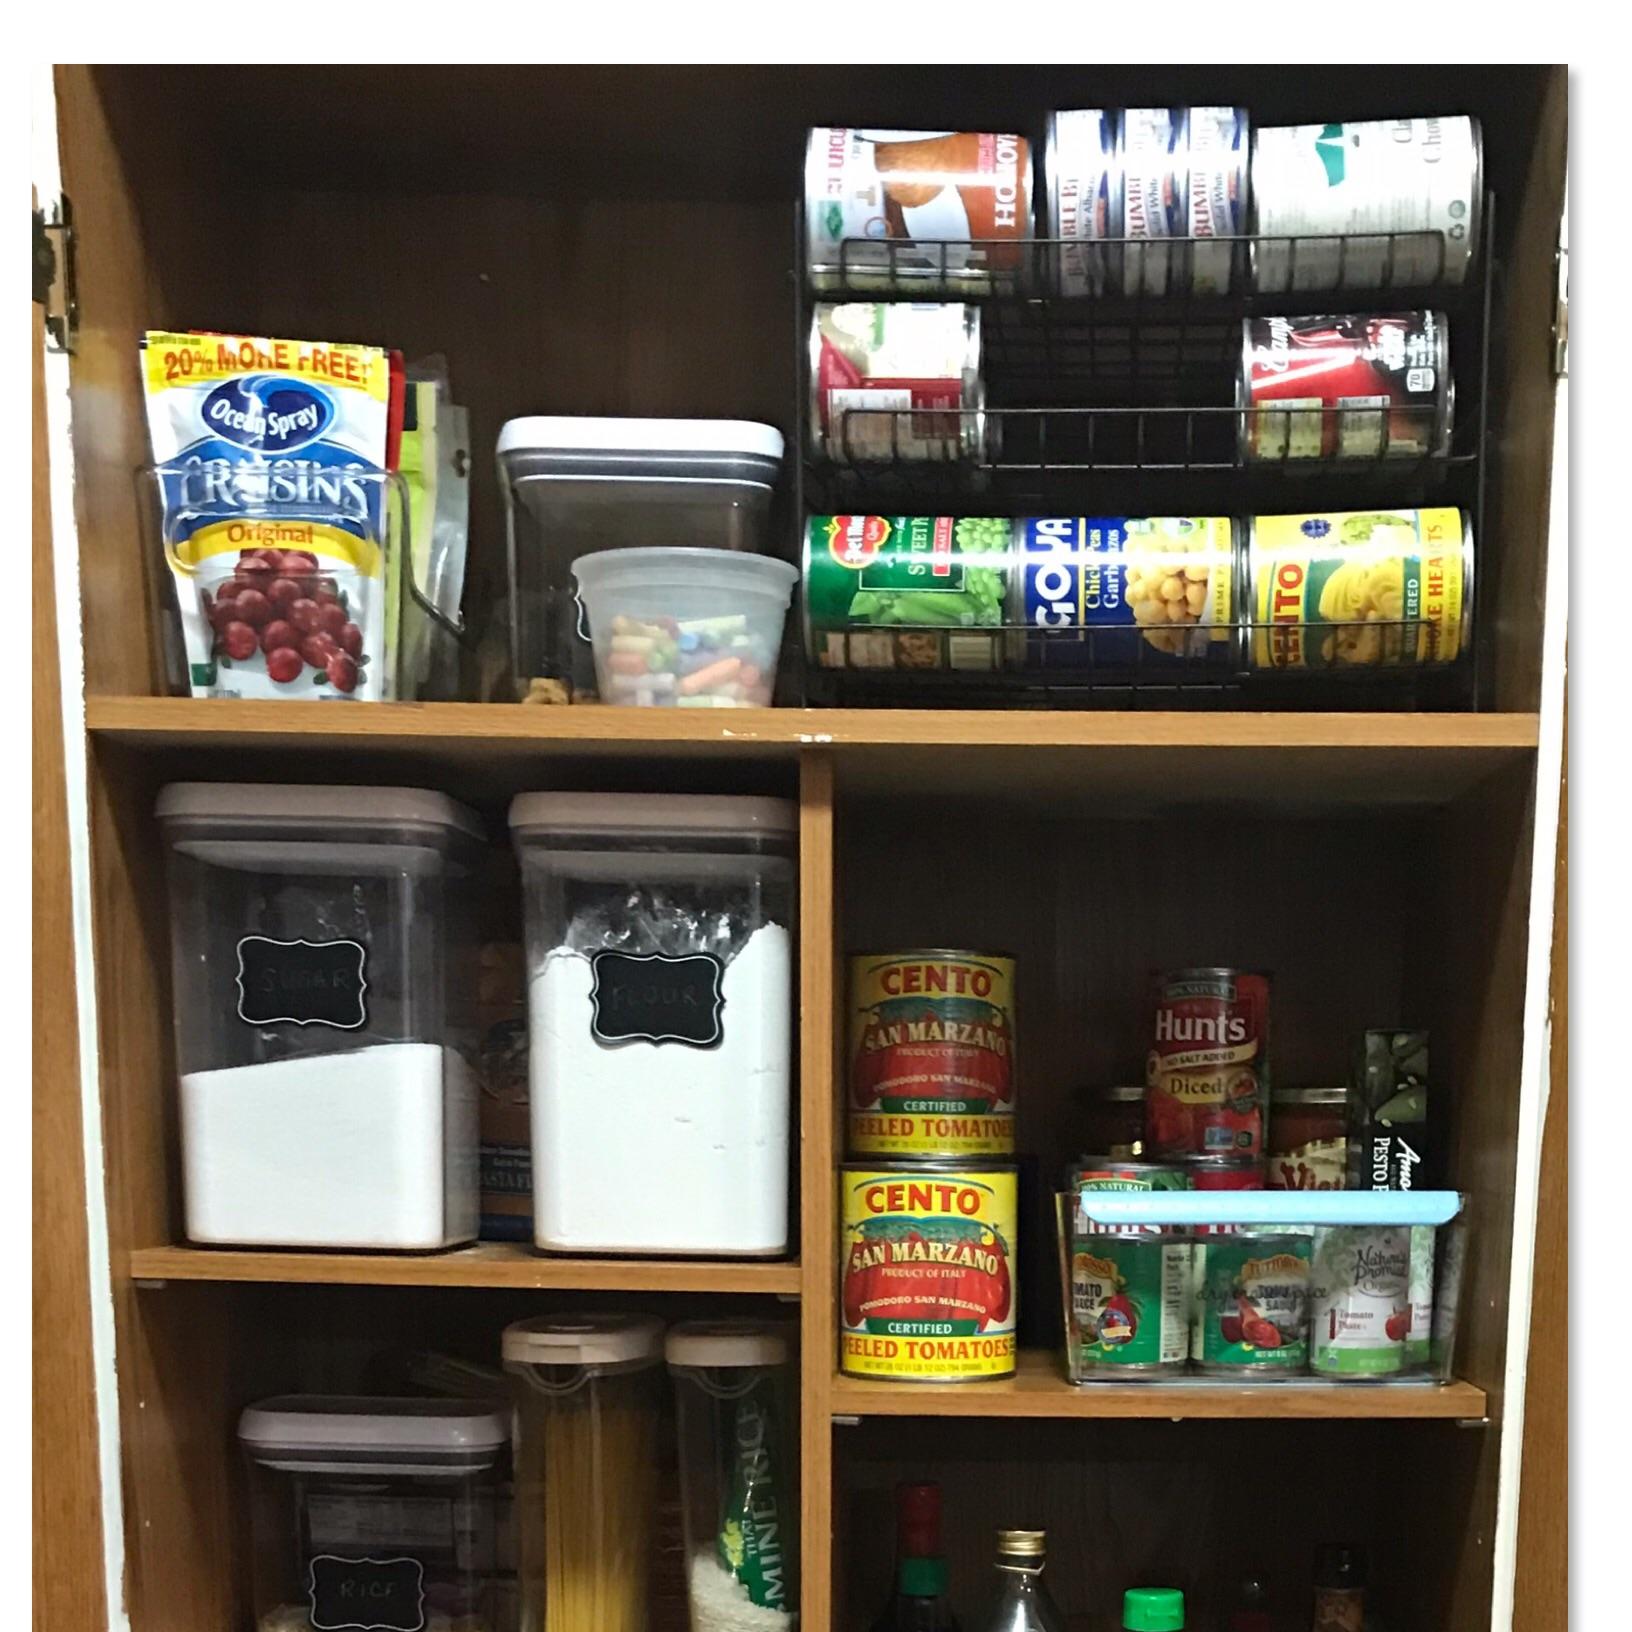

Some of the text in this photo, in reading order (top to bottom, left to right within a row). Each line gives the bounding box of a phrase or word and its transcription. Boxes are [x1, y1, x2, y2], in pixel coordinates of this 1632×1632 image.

[164, 342, 368, 384] 20% MORE FREE!
[210, 398, 319, 440] Ocean Spray
[181, 456, 369, 518] CRSINS
[227, 523, 314, 546] Original
[907, 523, 929, 576] SEET
[1035, 518, 1076, 634] GOYA
[1273, 563, 1304, 665] CENTO
[880, 965, 993, 997] CENTO
[866, 1020, 1007, 1056] SAN MARZANO
[1155, 1008, 1247, 1045] Hunt's
[1170, 1077, 1223, 1095] Diced
[903, 1100, 967, 1113] CERTIFIED
[1372, 1137, 1391, 1182] PESTO
[864, 1183, 981, 1216] CENTO
[852, 1241, 999, 1277] SAN MARZANO
[881, 1267, 967, 1279] PRODUCT OF ITALY
[859, 1295, 987, 1315] POMODORO SAN MARZANO
[887, 1322, 953, 1334] CERTIFIED
[906, 1339, 1009, 1361] TOMATOES
[741, 1519, 758, 1559] THAI
